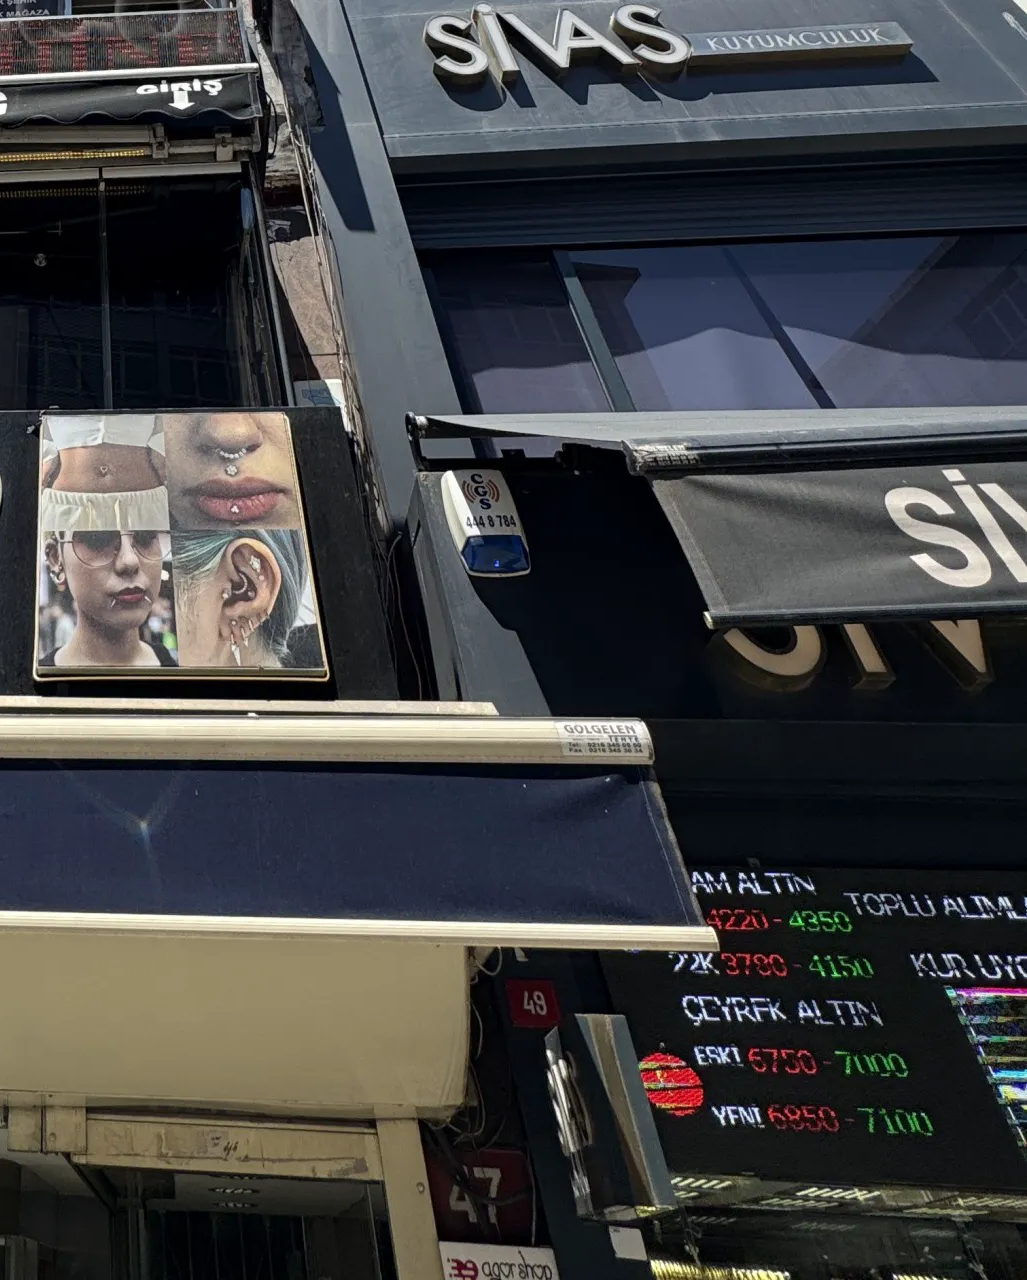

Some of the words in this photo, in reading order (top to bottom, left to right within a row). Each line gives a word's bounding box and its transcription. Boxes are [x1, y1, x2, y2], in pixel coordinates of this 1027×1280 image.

[6, 8, 51, 19] MAĞAZA
[423, 1, 693, 80] SİVAS
[705, 27, 896, 52] KUYUMCULUK
[136, 78, 223, 95] GİRİŞ
[466, 515, 486, 528] 444
[488, 515, 495, 528] 8
[496, 514, 517, 528] 784
[738, 872, 818, 896] ALTIN
[843, 892, 937, 917] TOPLU
[942, 894, 1027, 920] ALIML
[707, 908, 770, 931] 4220
[788, 910, 853, 933] 4350
[809, 954, 874, 979] 4150
[909, 952, 976, 979] KUR
[523, 990, 548, 1016] 49
[797, 999, 885, 1027] ALTIN
[747, 1047, 818, 1075] 6750
[767, 1103, 840, 1133] 6850
[856, 1106, 935, 1137] 7100
[449, 1164, 502, 1224] 47
